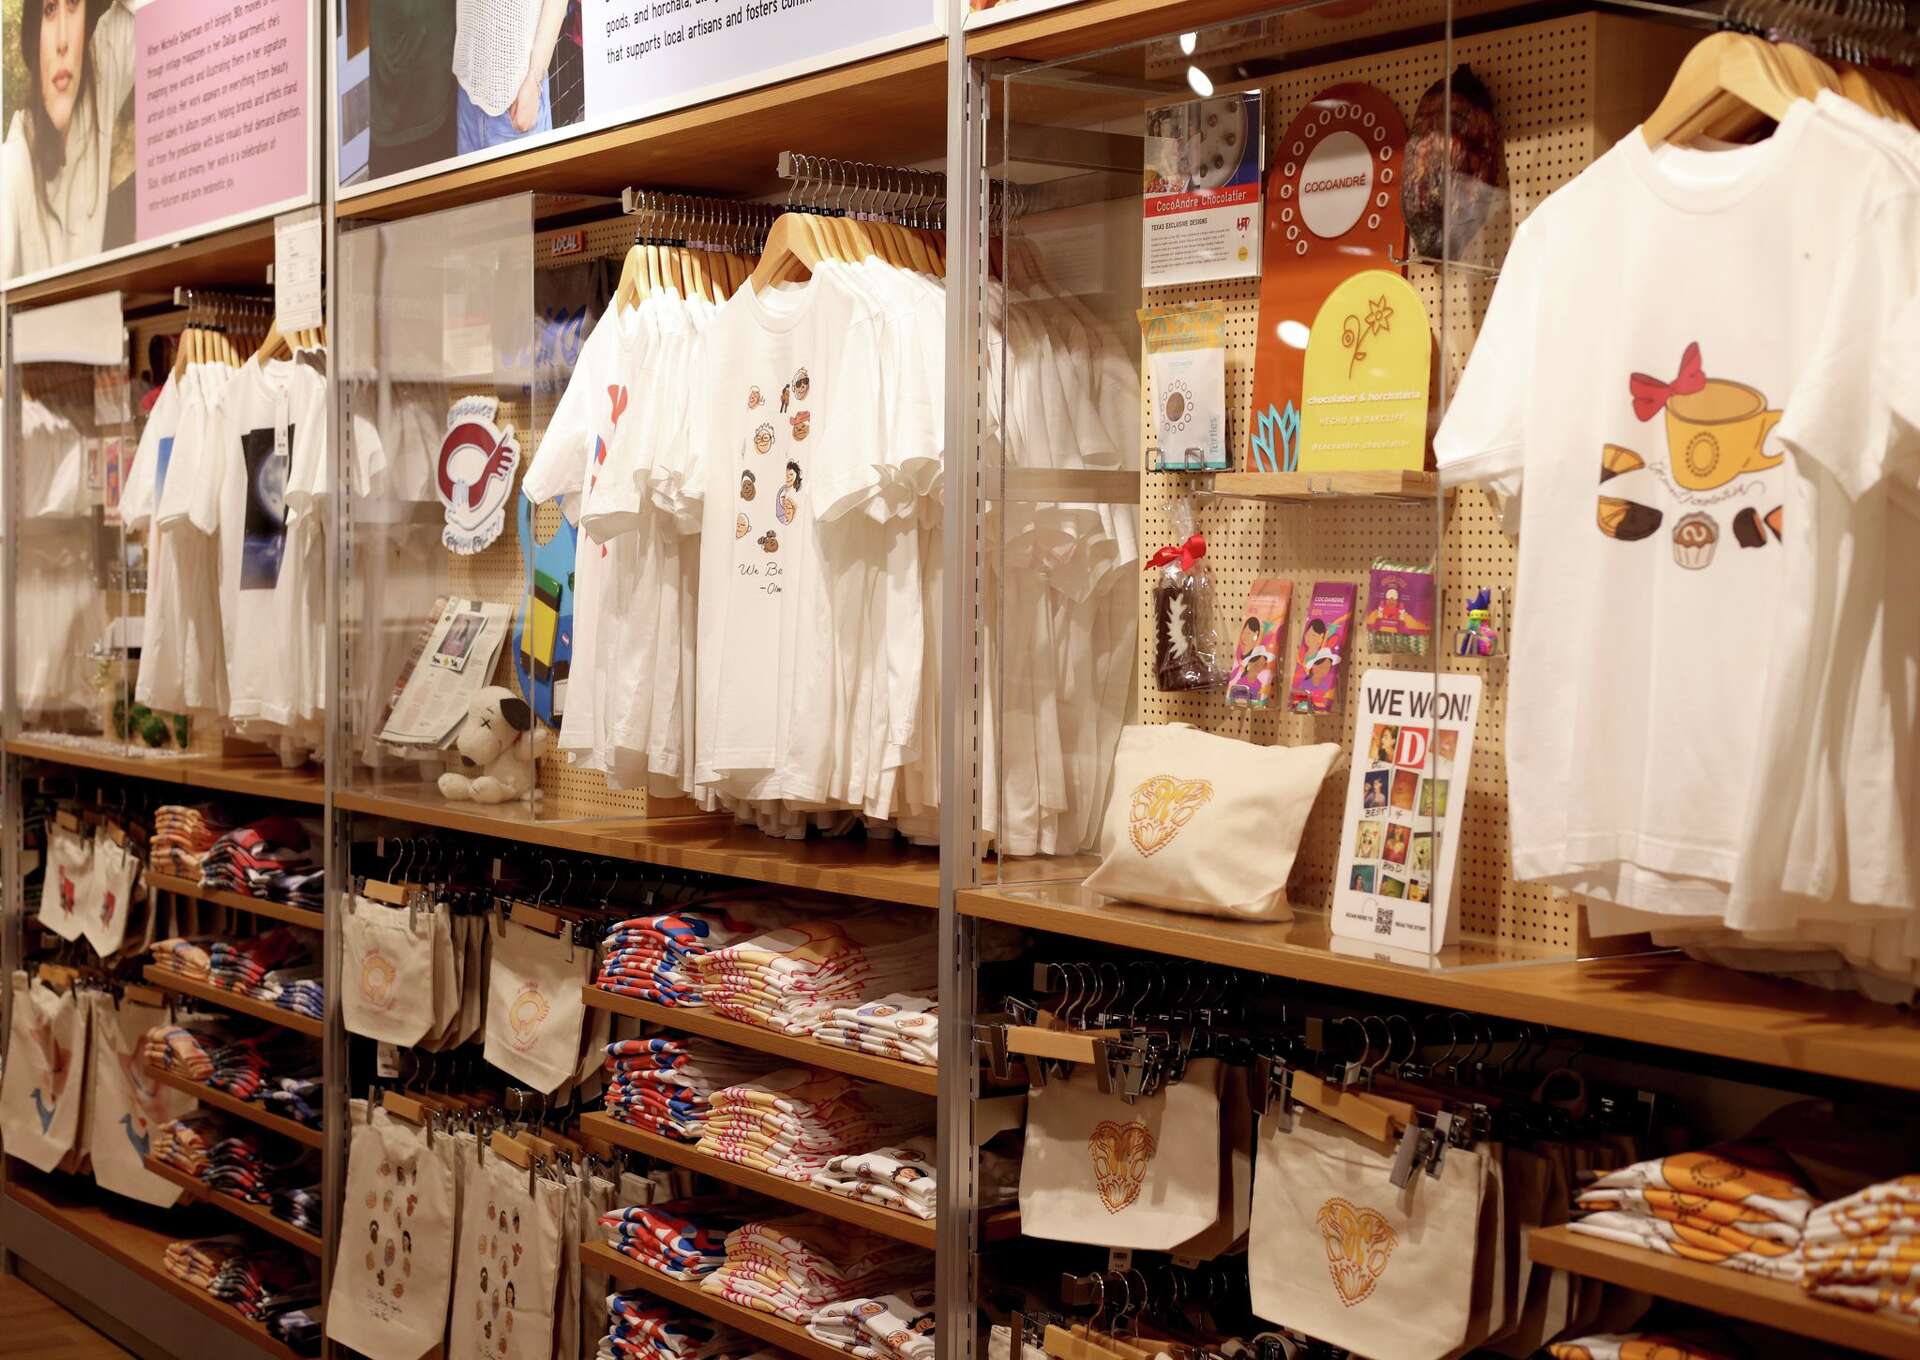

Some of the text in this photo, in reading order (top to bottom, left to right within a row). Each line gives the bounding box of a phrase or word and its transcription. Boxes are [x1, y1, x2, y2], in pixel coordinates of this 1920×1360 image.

[606, 0, 692, 38] goods, and horchata,
[607, 44, 623, 64] that
[626, 34, 661, 60] supports
[664, 25, 685, 47] local
[688, 17, 723, 40] artisans
[726, 8, 743, 28] and
[746, 1, 778, 22] fosters
[1305, 173, 1366, 193] COCOANDRÉ
[1156, 190, 1247, 212] CocoAndre Chocolatier
[1152, 218, 1208, 231] TEXAS EXCLUSIVE DESIGNS
[738, 563, 760, 576] We
[1367, 688, 1471, 721] WE WON!
[1398, 731, 1425, 766] D
